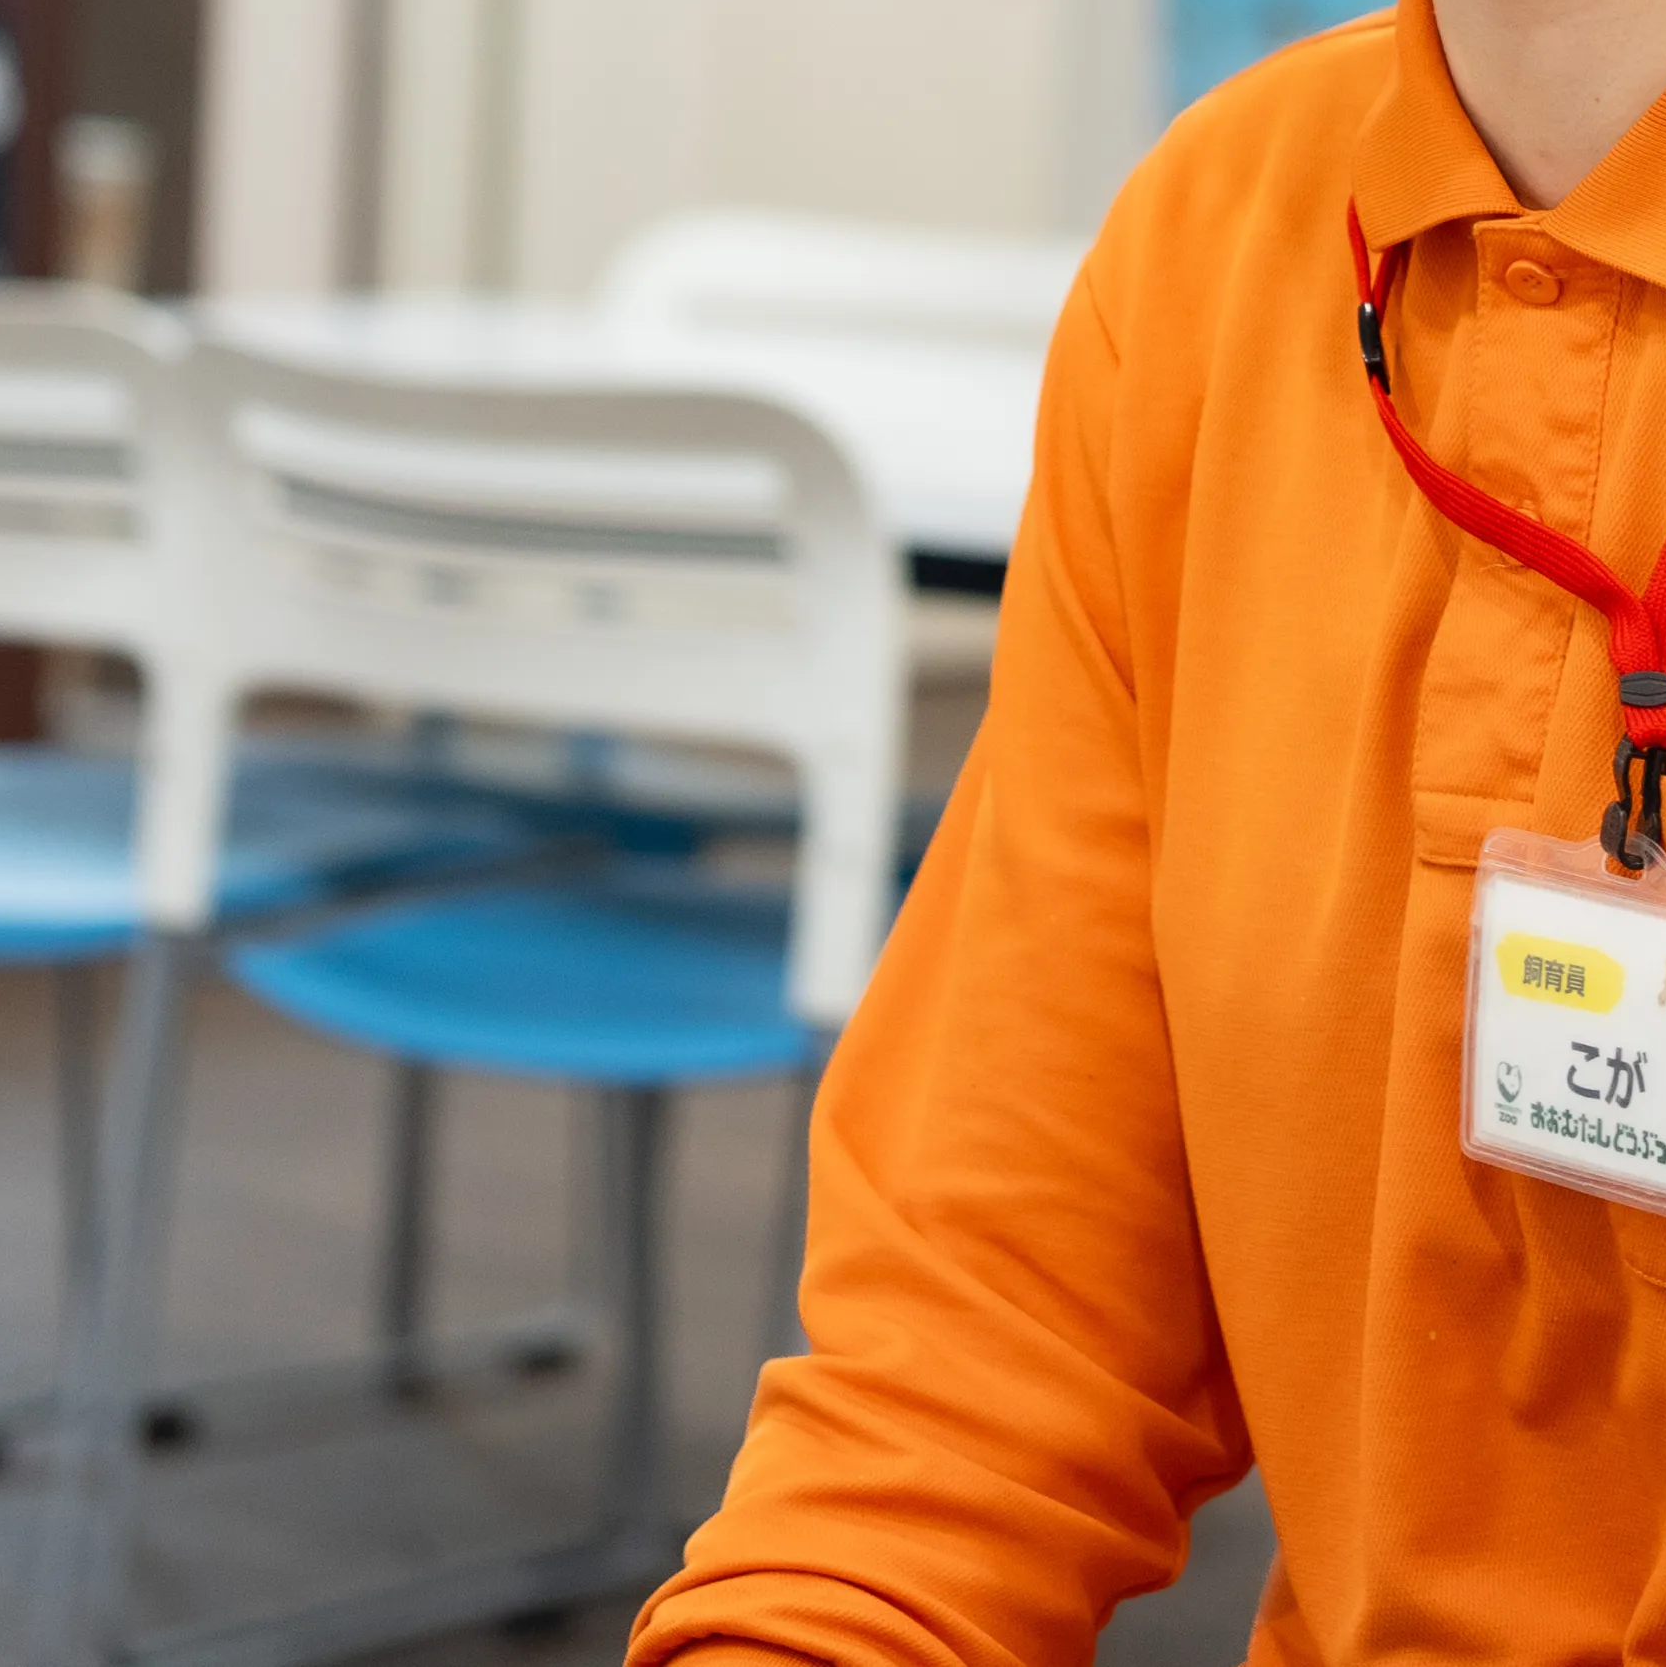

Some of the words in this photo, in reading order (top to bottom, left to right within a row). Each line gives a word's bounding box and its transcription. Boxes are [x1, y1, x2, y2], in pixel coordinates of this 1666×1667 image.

[1523, 954, 1586, 998] 飼育員
[1566, 1041, 1648, 1109] こが
